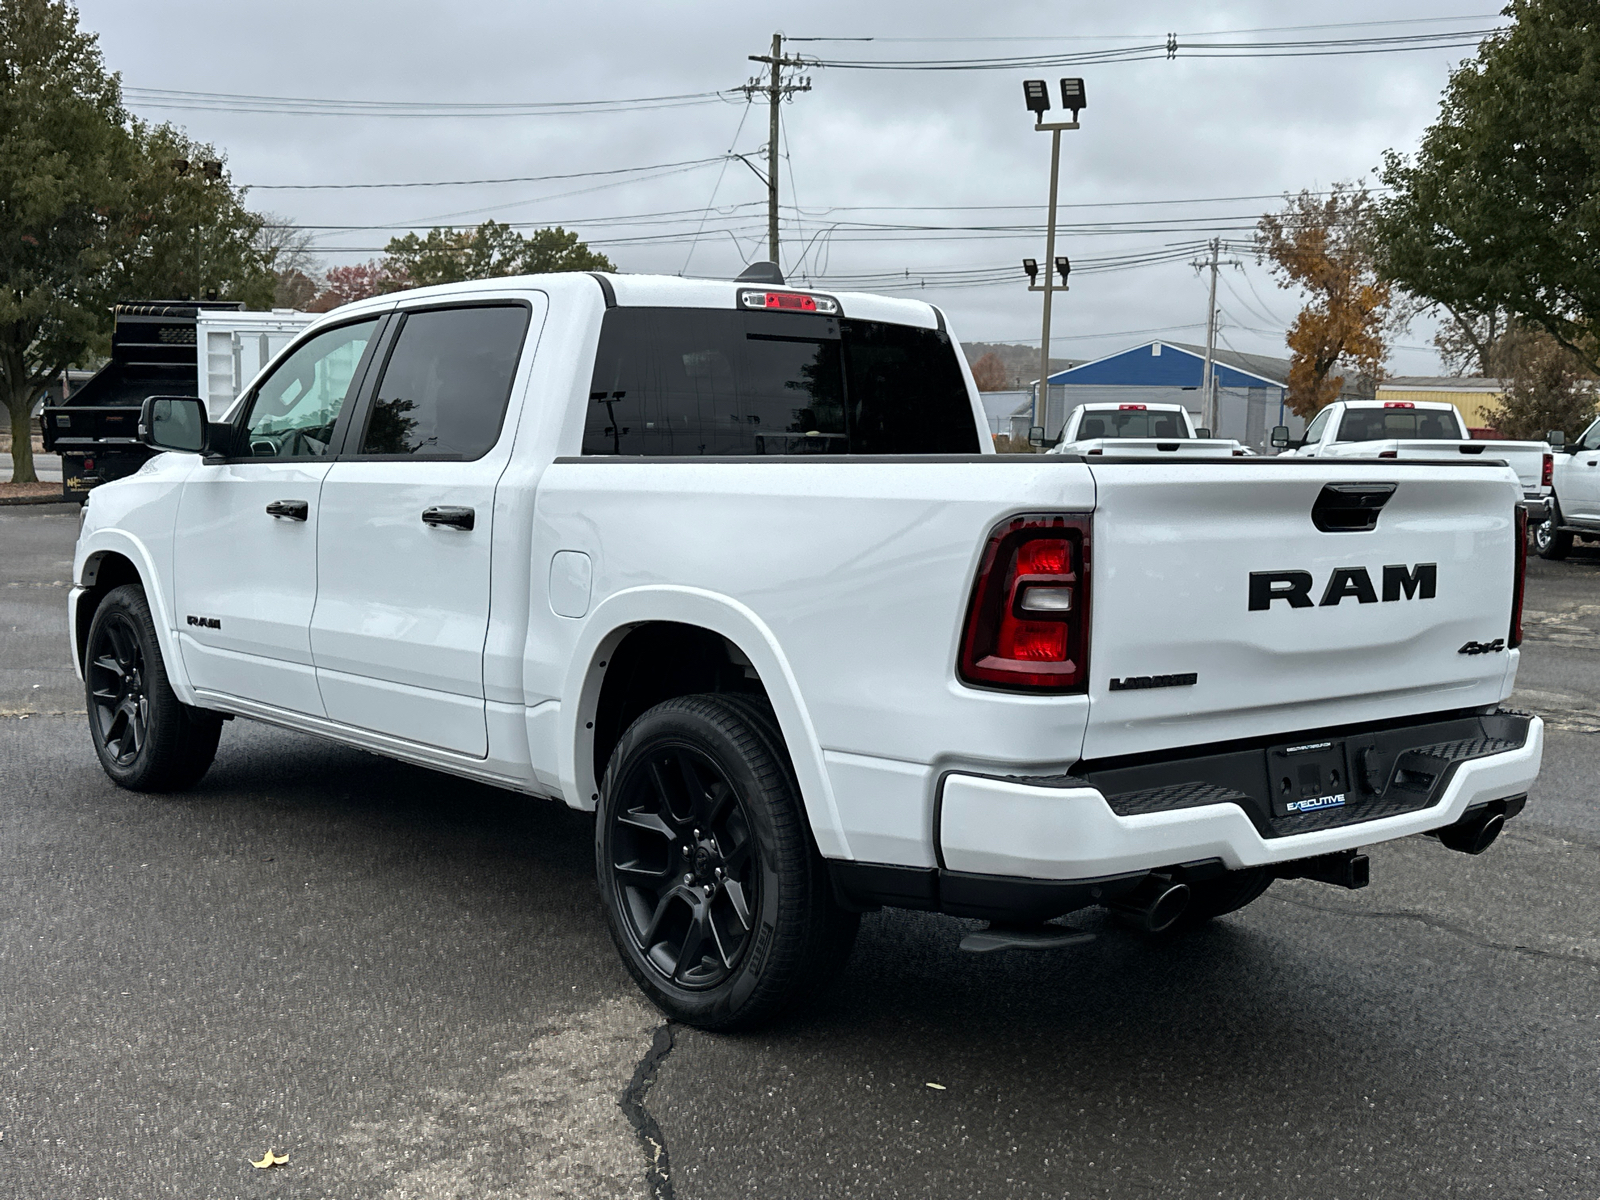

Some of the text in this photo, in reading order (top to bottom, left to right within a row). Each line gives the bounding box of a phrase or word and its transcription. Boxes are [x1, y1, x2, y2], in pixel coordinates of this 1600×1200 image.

[1248, 562, 1437, 611] RAM
[187, 615, 221, 629] RAM
[1287, 794, 1345, 811] EXECUTIVE
